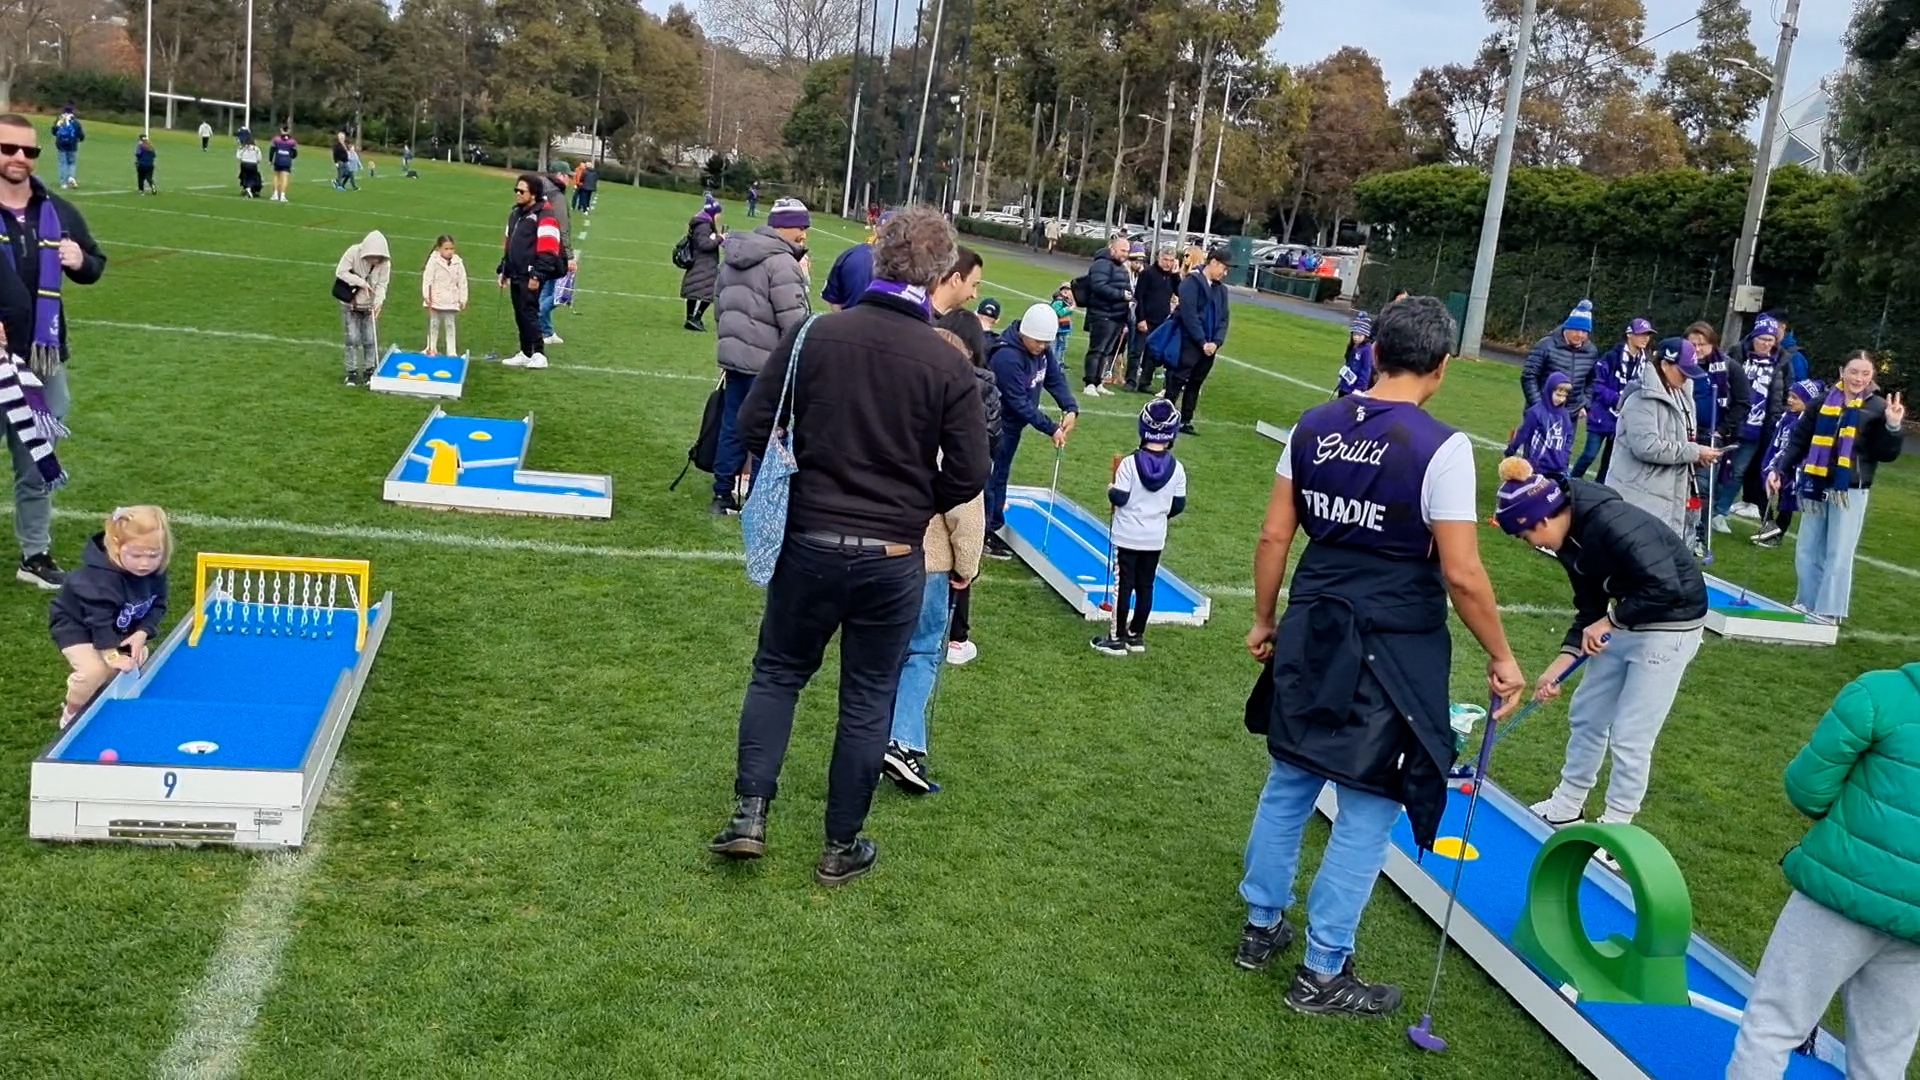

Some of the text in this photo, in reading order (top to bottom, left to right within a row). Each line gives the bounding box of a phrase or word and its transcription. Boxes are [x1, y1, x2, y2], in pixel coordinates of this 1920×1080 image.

[1313, 433, 1389, 465] Grill'd
[1301, 488, 1386, 532] TRADIE
[163, 771, 177, 799] 9
